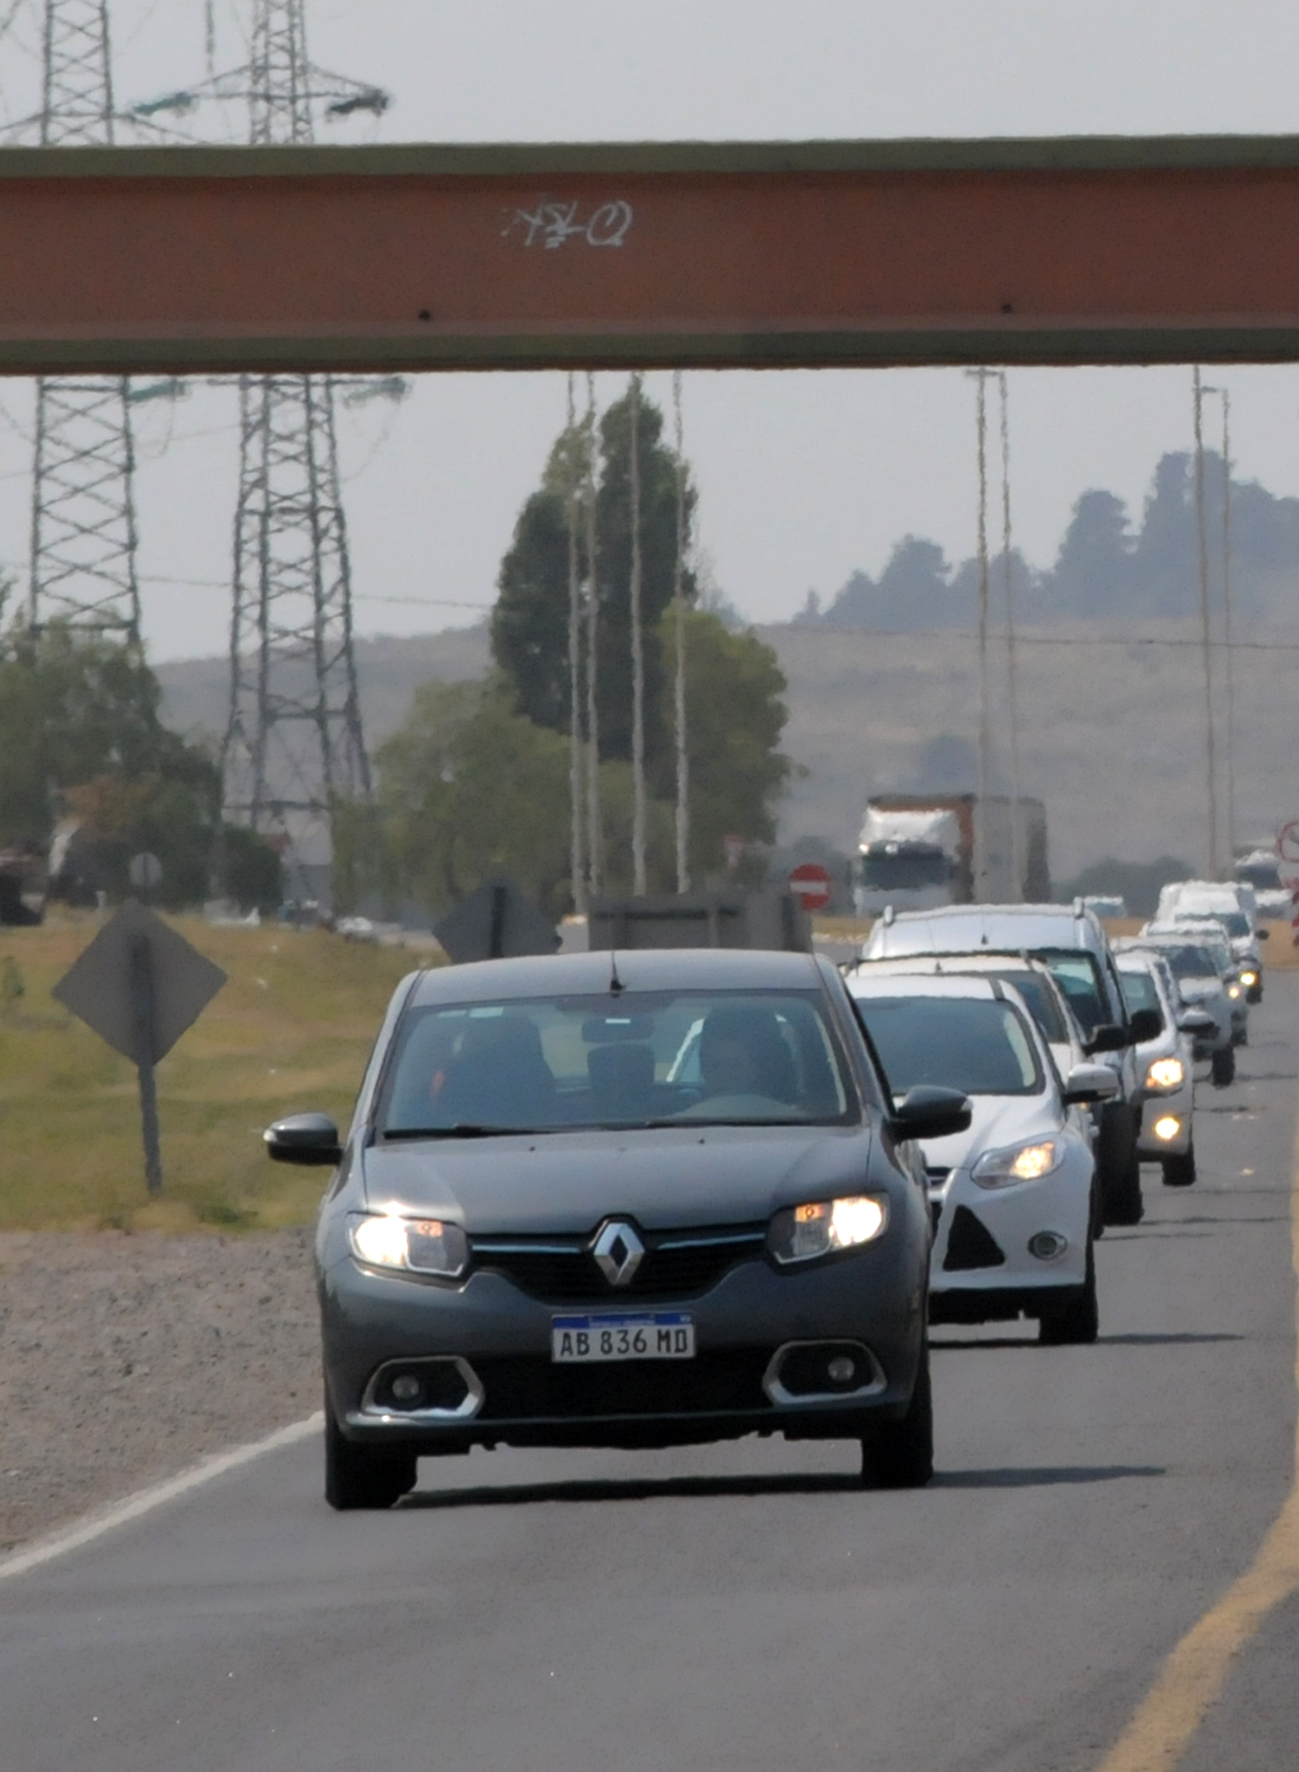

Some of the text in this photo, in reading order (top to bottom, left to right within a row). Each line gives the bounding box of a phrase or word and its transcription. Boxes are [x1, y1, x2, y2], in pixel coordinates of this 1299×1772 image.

[560, 1328, 688, 1356] AB 836 MD
